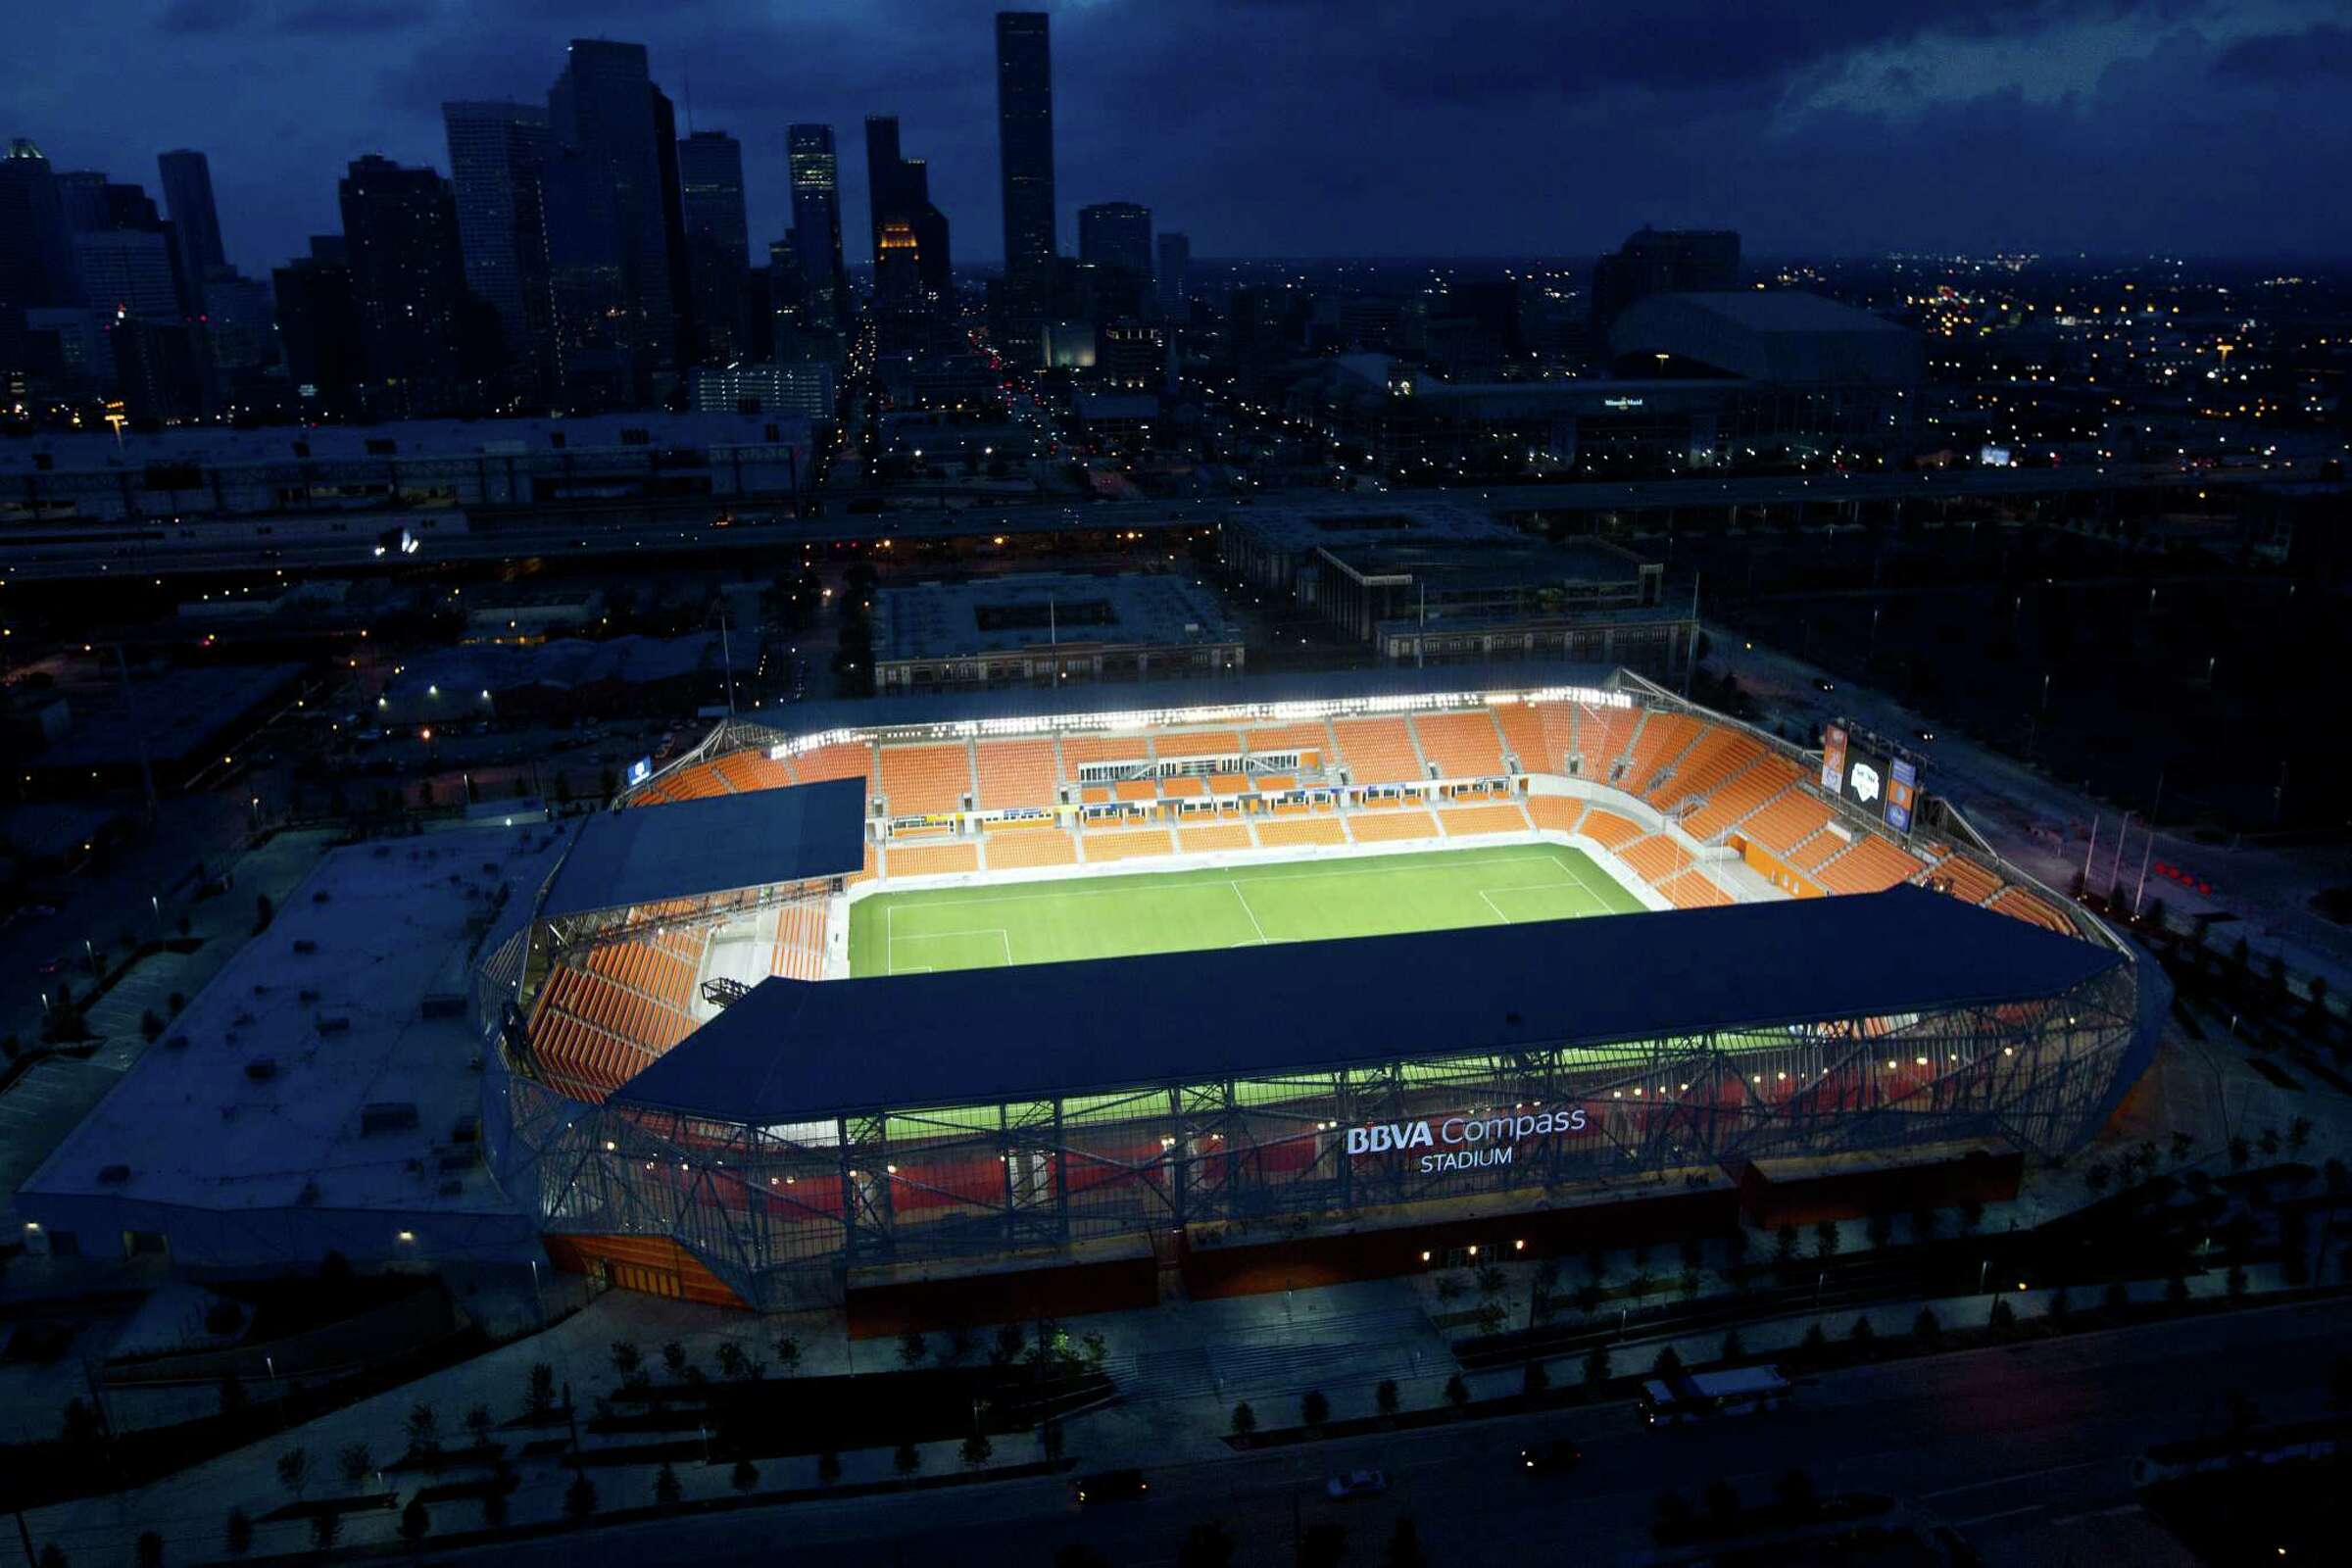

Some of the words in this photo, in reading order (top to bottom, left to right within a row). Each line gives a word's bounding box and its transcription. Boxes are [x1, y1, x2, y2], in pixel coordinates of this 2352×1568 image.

[1348, 1120, 1434, 1154] BBVA
[1442, 1109, 1586, 1144] Compass
[1420, 1147, 1512, 1173] STADIUM
